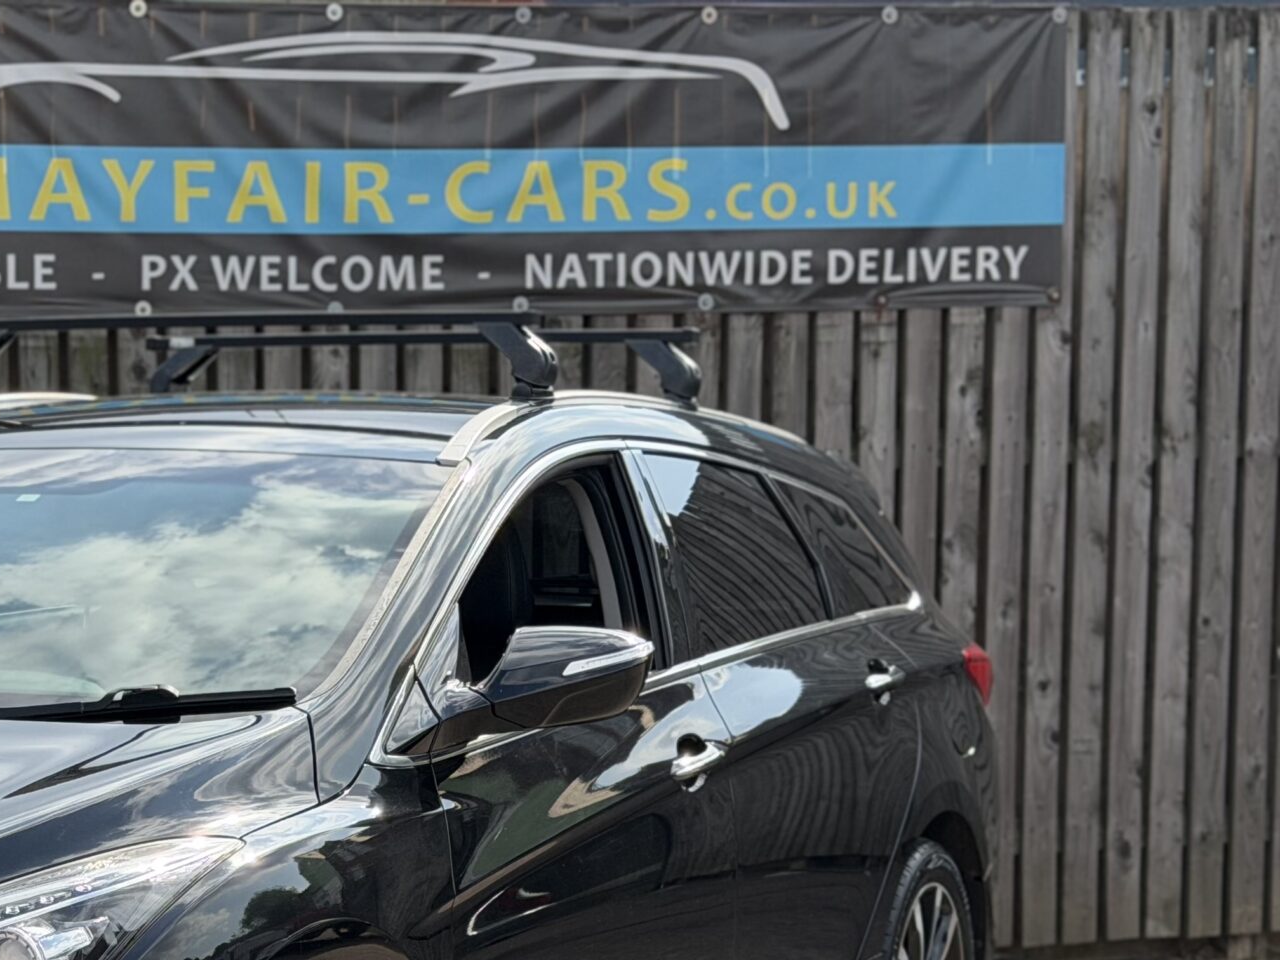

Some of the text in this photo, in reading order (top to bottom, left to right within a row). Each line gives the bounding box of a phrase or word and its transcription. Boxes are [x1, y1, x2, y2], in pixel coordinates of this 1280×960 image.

[141, 255, 198, 291] PX
[211, 255, 446, 292] WELCOME
[524, 249, 813, 289] NATIONWIDE
[827, 245, 1029, 284] DELIVERY
